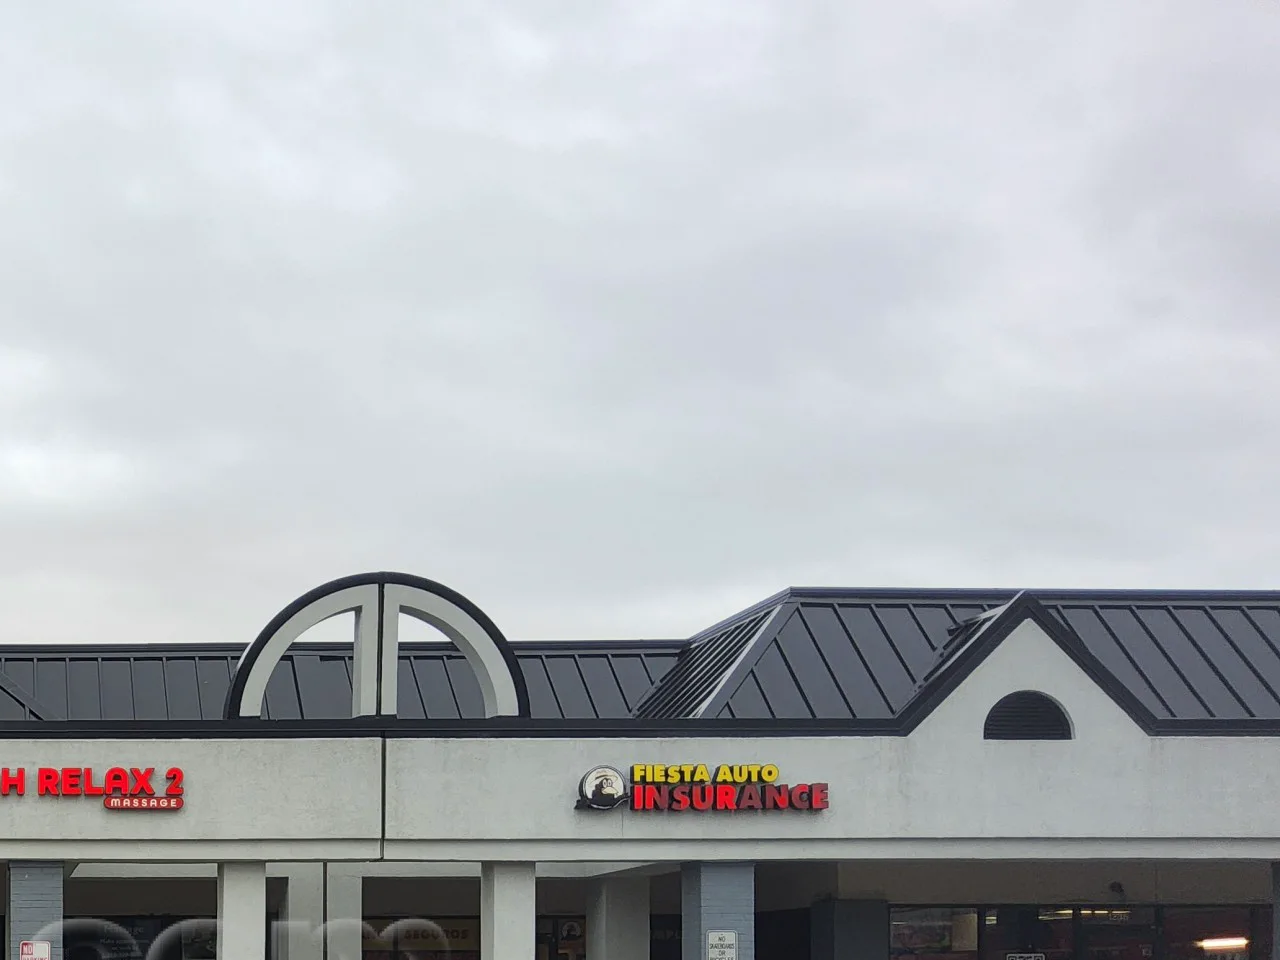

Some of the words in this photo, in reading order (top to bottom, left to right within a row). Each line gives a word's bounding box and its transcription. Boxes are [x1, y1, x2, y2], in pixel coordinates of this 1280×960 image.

[37, 766, 155, 796] RELAX
[165, 766, 185, 796] 2
[631, 763, 711, 783] FIESTA
[712, 763, 780, 783] AUTO
[110, 798, 178, 808] MASSAGE
[631, 782, 830, 811] INSURANCE
[22, 944, 33, 955] NO
